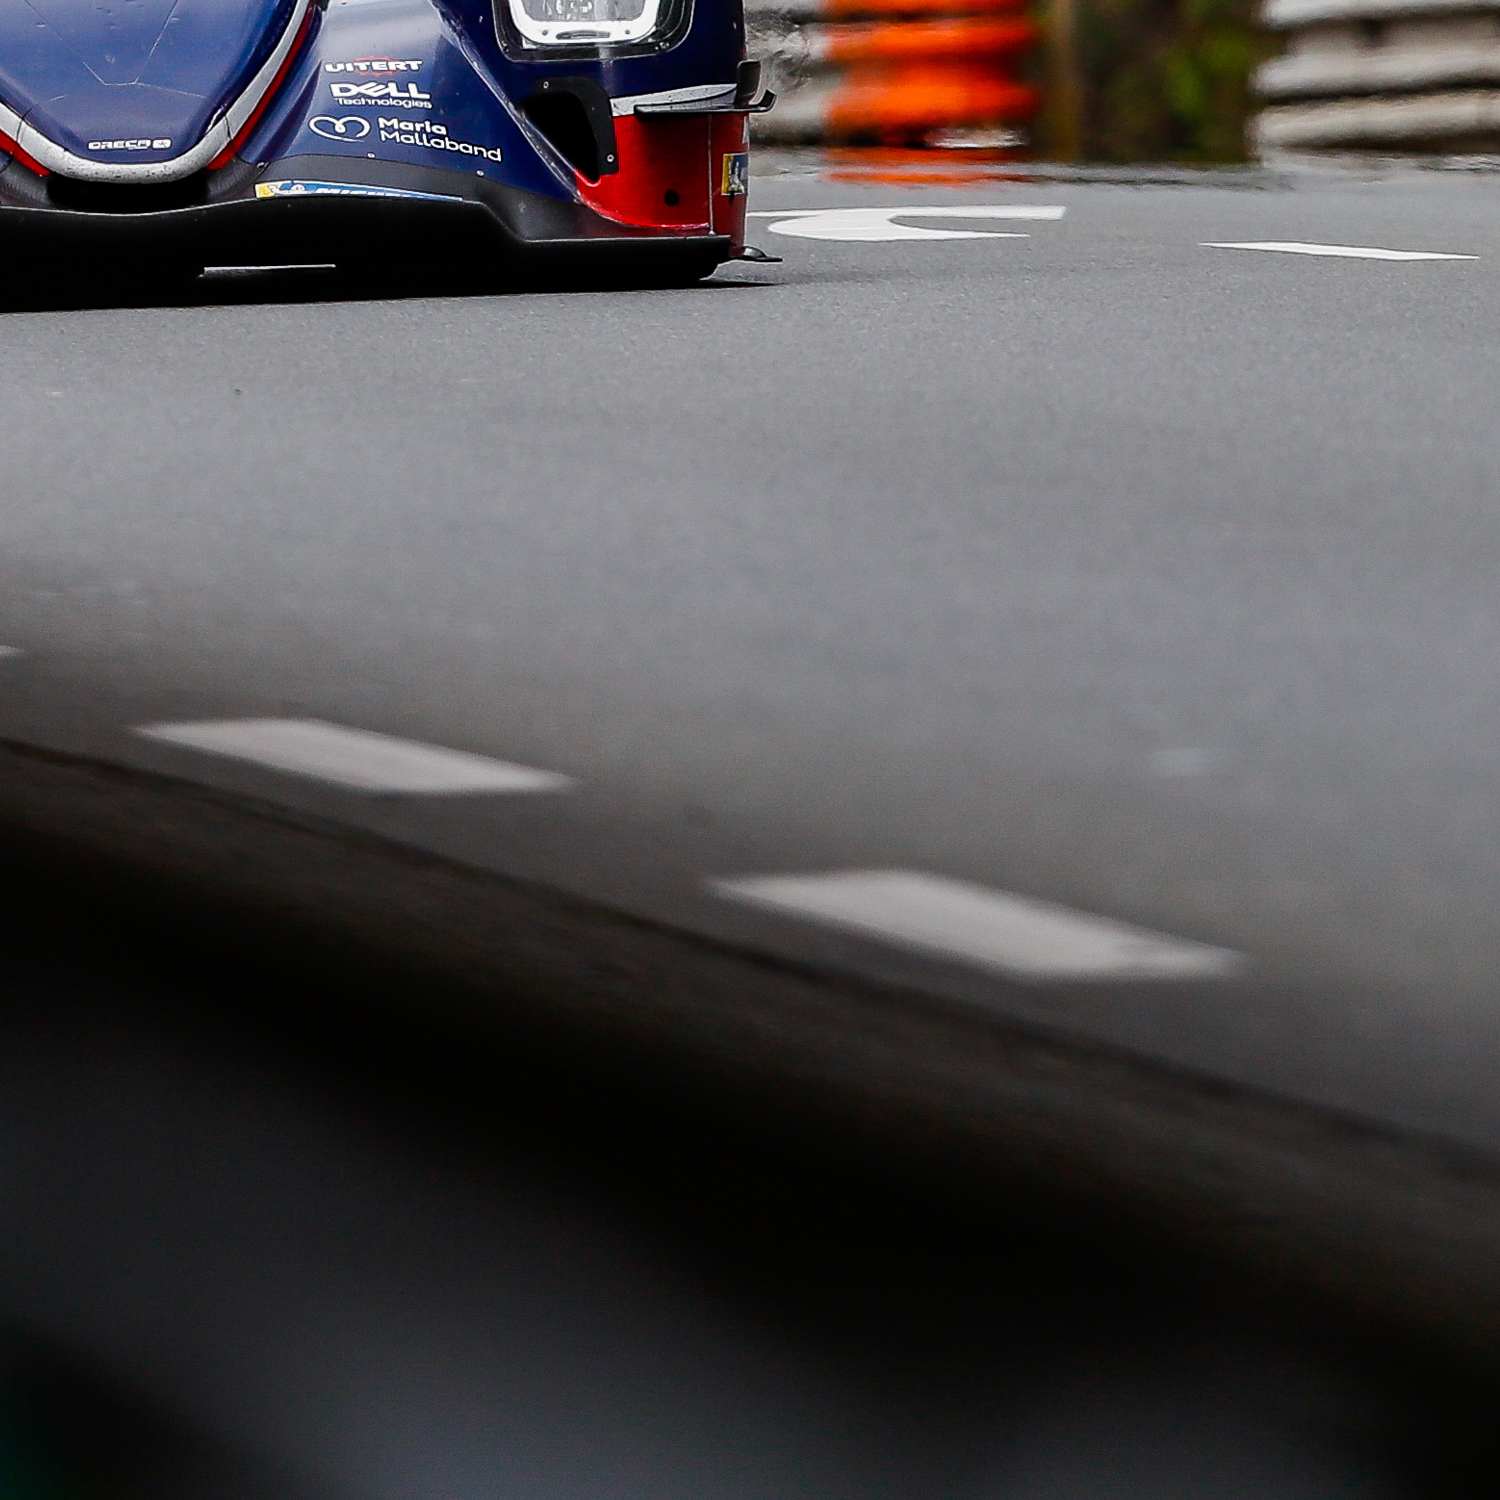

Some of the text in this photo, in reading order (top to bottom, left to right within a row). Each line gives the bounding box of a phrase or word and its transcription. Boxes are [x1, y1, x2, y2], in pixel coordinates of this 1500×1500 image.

[324, 60, 423, 73] UITERT
[329, 81, 431, 99] DELL
[335, 97, 433, 109] Technologies
[377, 117, 448, 136] Maria
[380, 130, 502, 162] Mallaband
